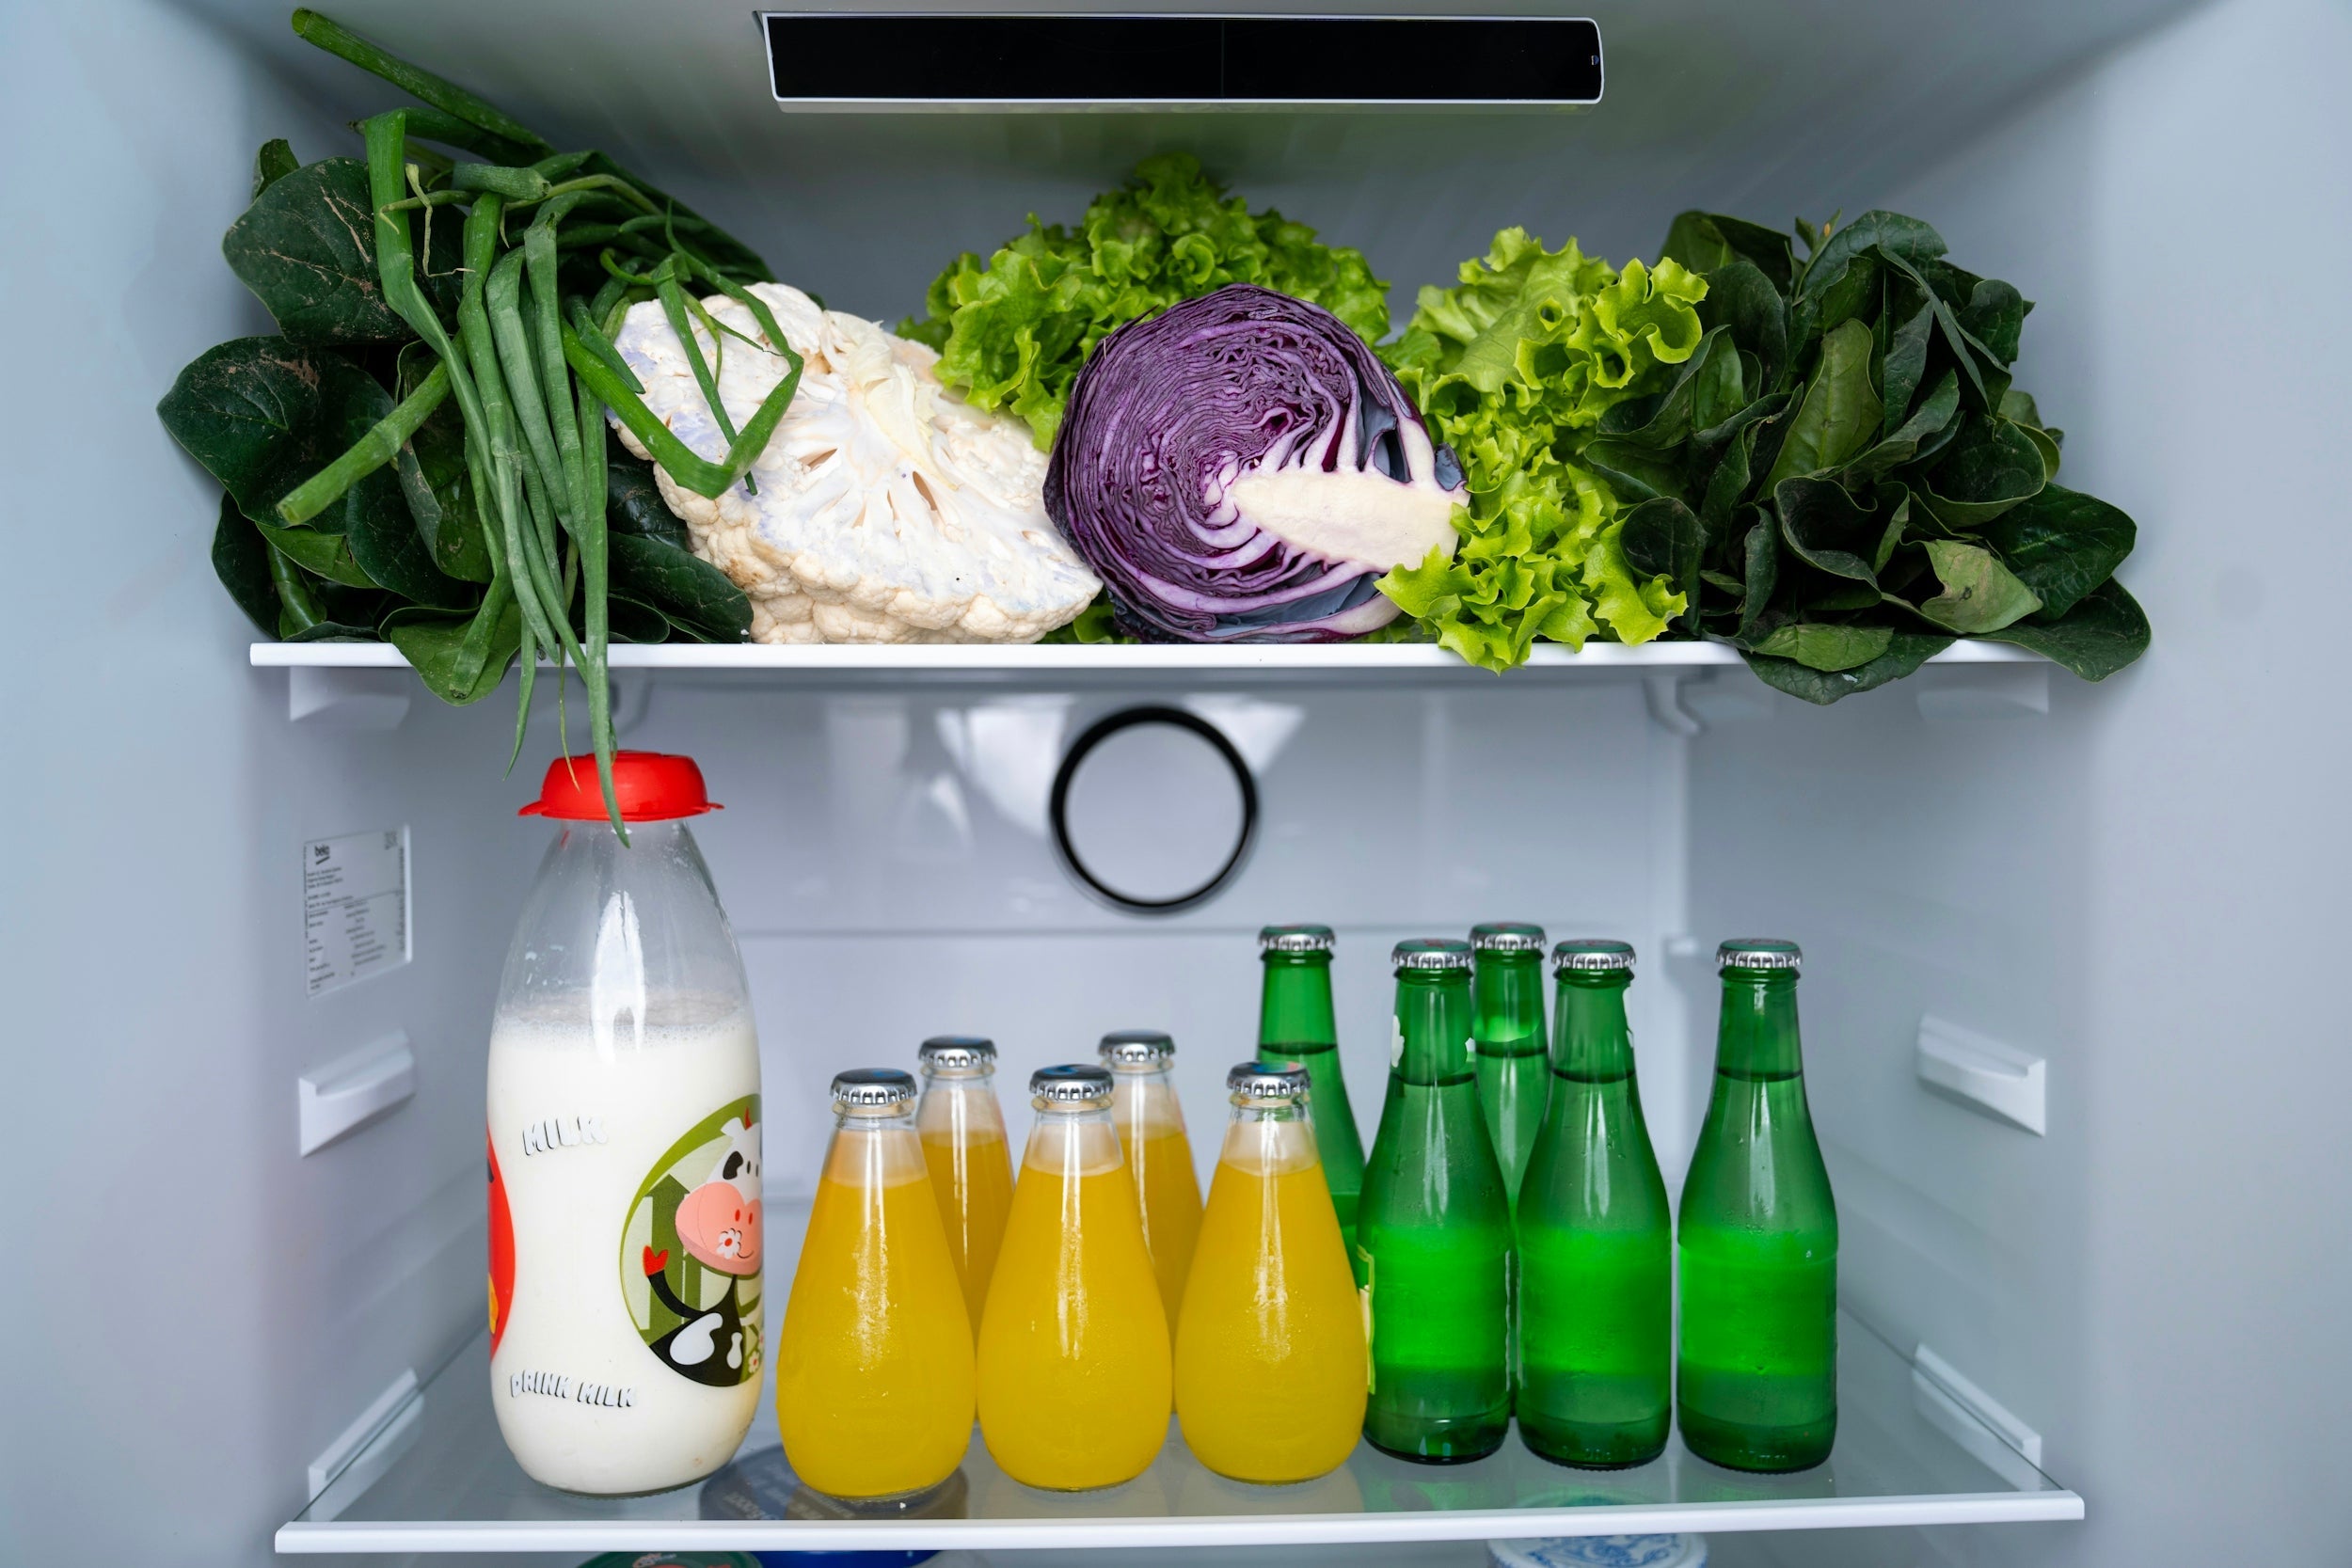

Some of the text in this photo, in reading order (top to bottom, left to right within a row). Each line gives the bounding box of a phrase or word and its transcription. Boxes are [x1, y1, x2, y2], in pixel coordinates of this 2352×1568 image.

[522, 1116, 608, 1156] MILK
[510, 1370, 637, 1407] DRINK MILK
